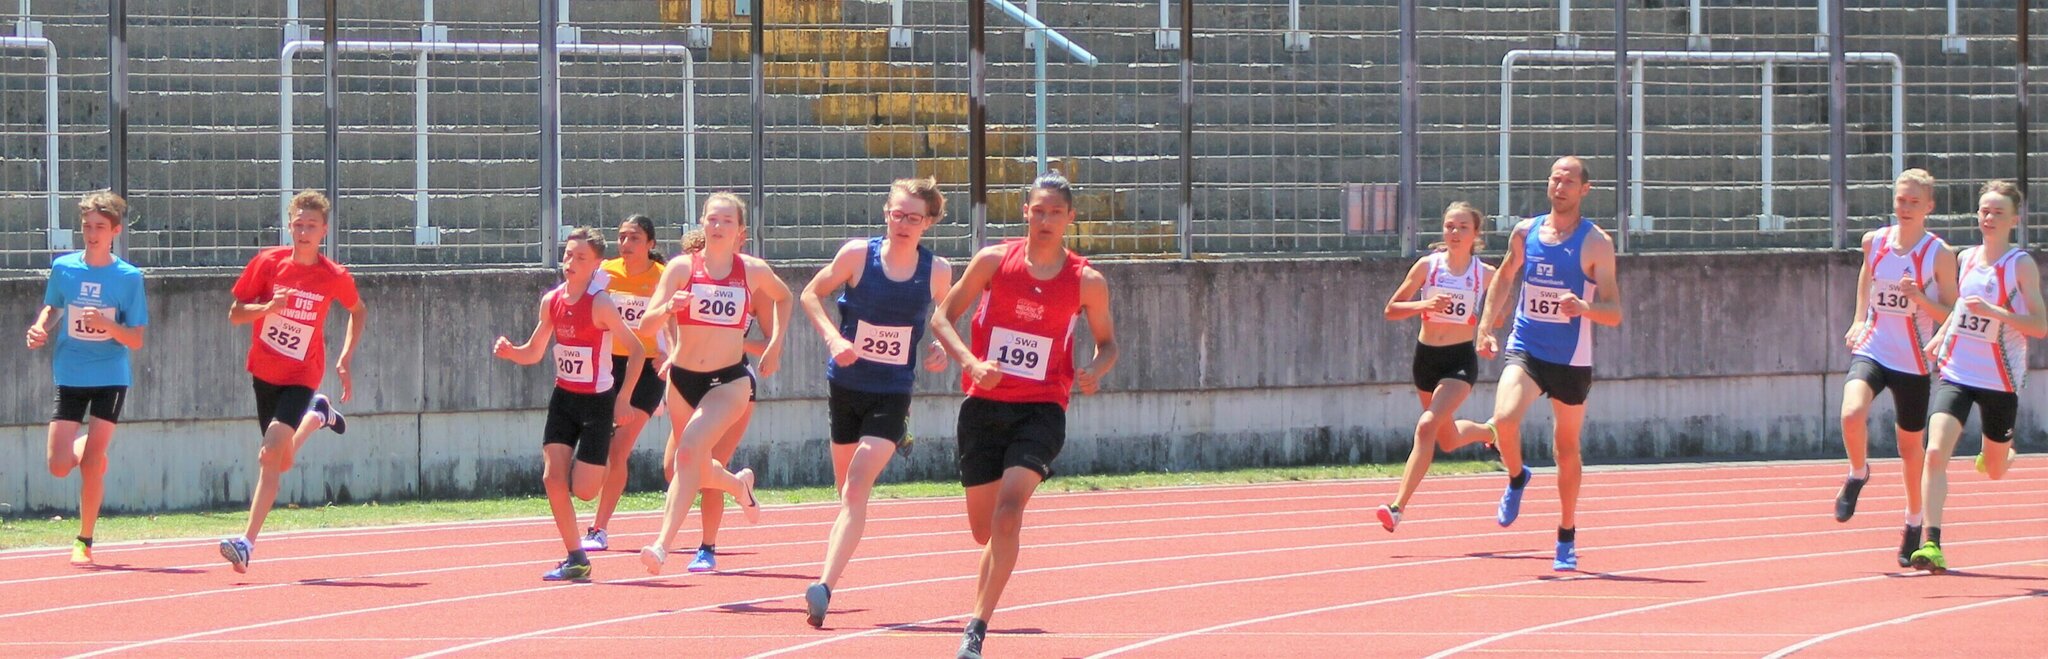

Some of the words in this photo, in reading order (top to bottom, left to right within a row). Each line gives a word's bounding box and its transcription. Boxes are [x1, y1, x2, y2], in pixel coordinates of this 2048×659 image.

[714, 289, 734, 298] swa
[1540, 291, 1558, 299] swa
[1877, 292, 1909, 309] 130
[294, 297, 314, 311] U15
[698, 298, 737, 317] 206
[1437, 302, 1466, 316] 36
[1530, 299, 1561, 315] 167
[282, 322, 302, 334] swa
[1957, 313, 1991, 333] 137
[267, 326, 301, 350] 252
[879, 330, 899, 339] swa
[862, 337, 901, 357] 293
[1015, 336, 1038, 349] swa
[563, 350, 580, 358] swa
[997, 345, 1039, 369] 199
[558, 357, 584, 375] 207
